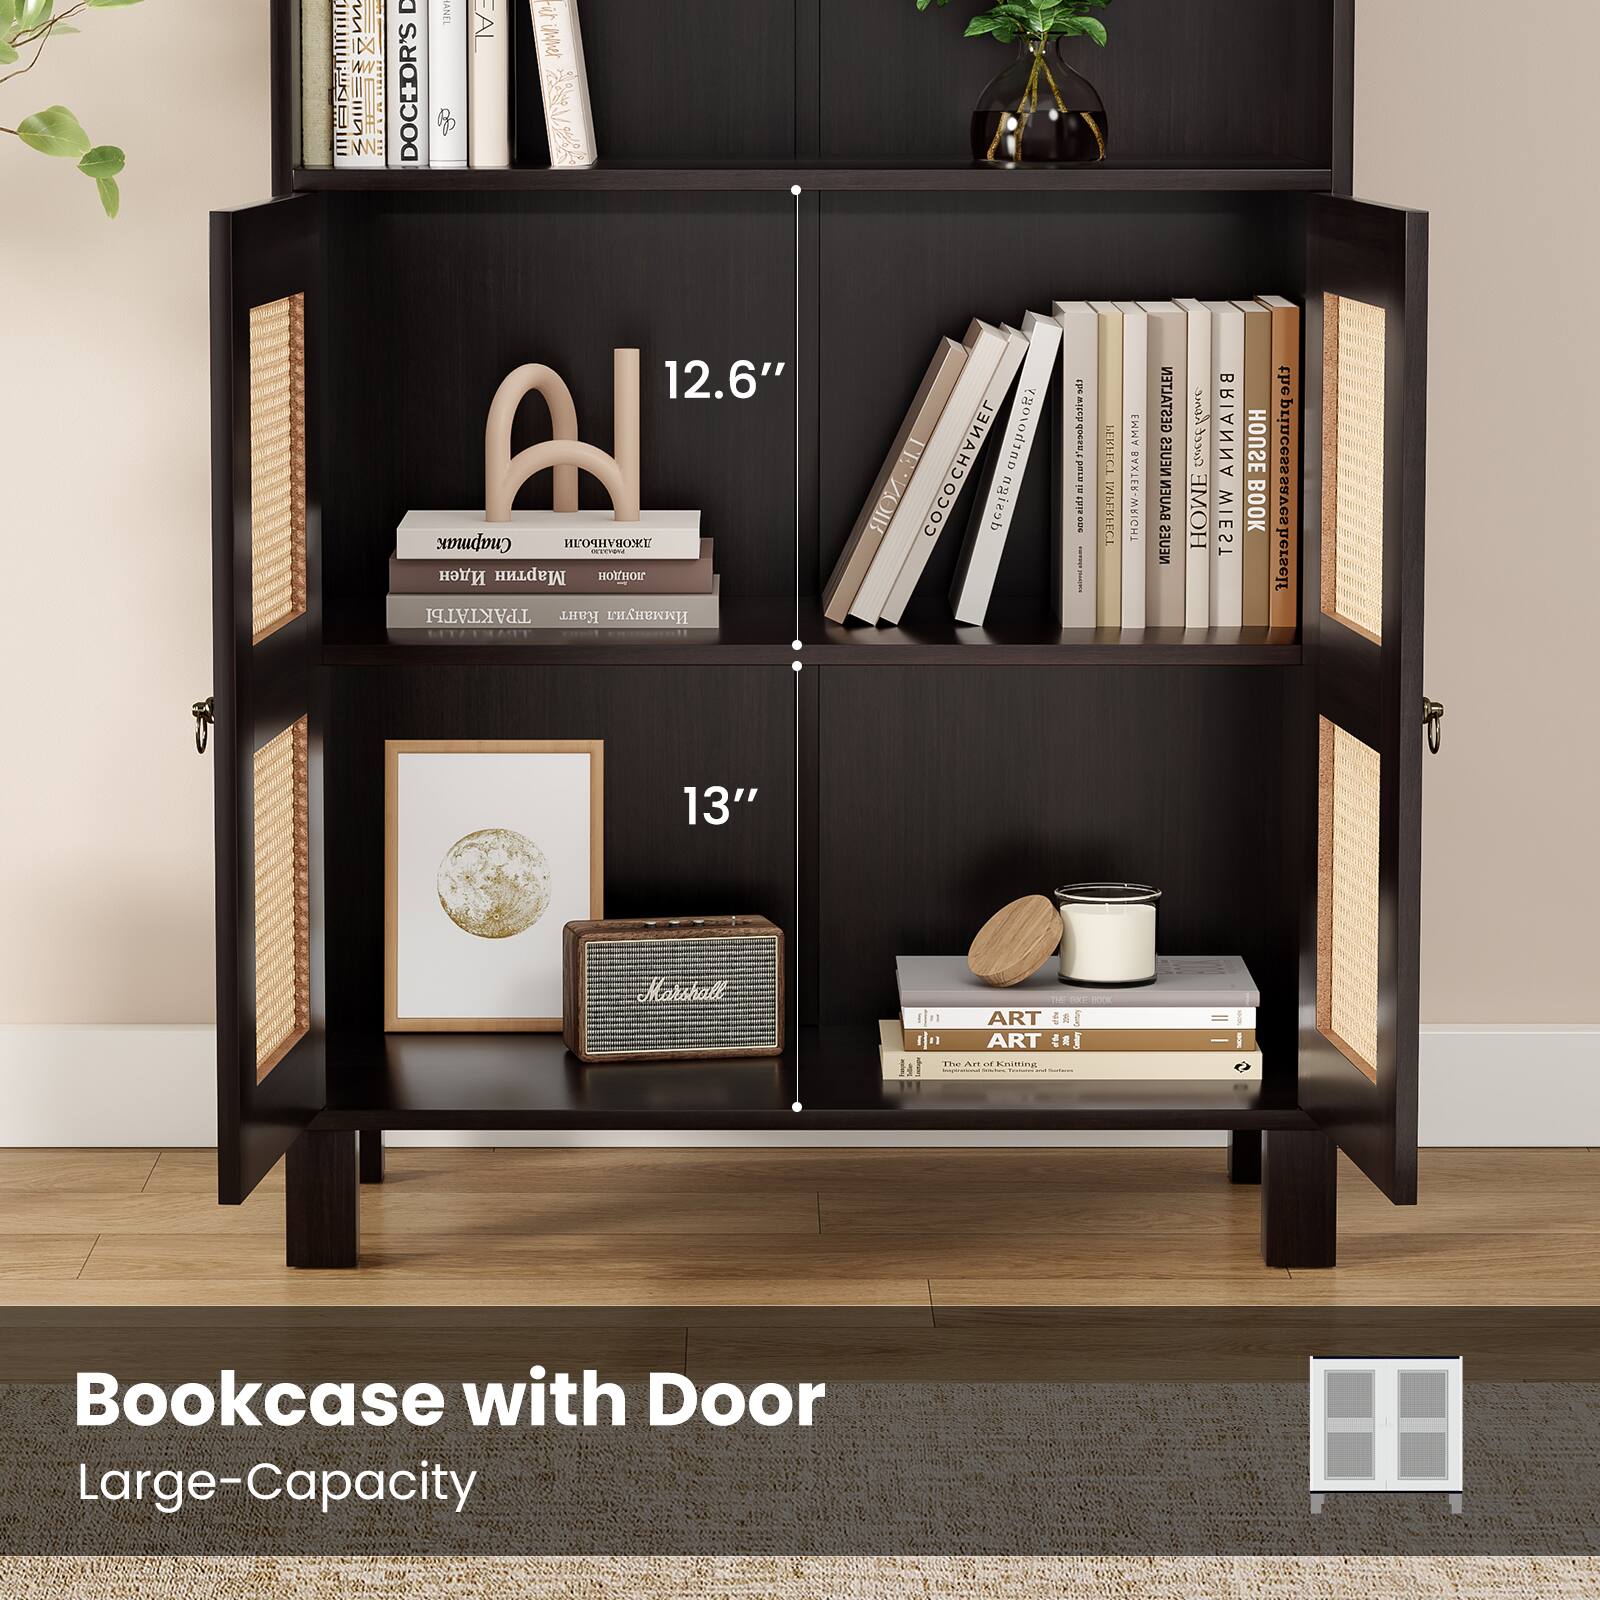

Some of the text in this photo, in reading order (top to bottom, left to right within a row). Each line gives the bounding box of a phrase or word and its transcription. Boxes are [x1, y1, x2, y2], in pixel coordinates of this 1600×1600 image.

[436, 533, 512, 553] Спартак
[564, 538, 652, 548] ДЖОВАНЬОЛИ
[439, 567, 566, 586] Мартин Иден
[425, 608, 531, 624] ТРАКТАТЫ
[559, 608, 688, 625] Иммануил Кант
[637, 976, 728, 1003] Marshall
[987, 1010, 1042, 1026] ART
[986, 1032, 1042, 1049] ART
[996, 1060, 1038, 1068] Knitting
